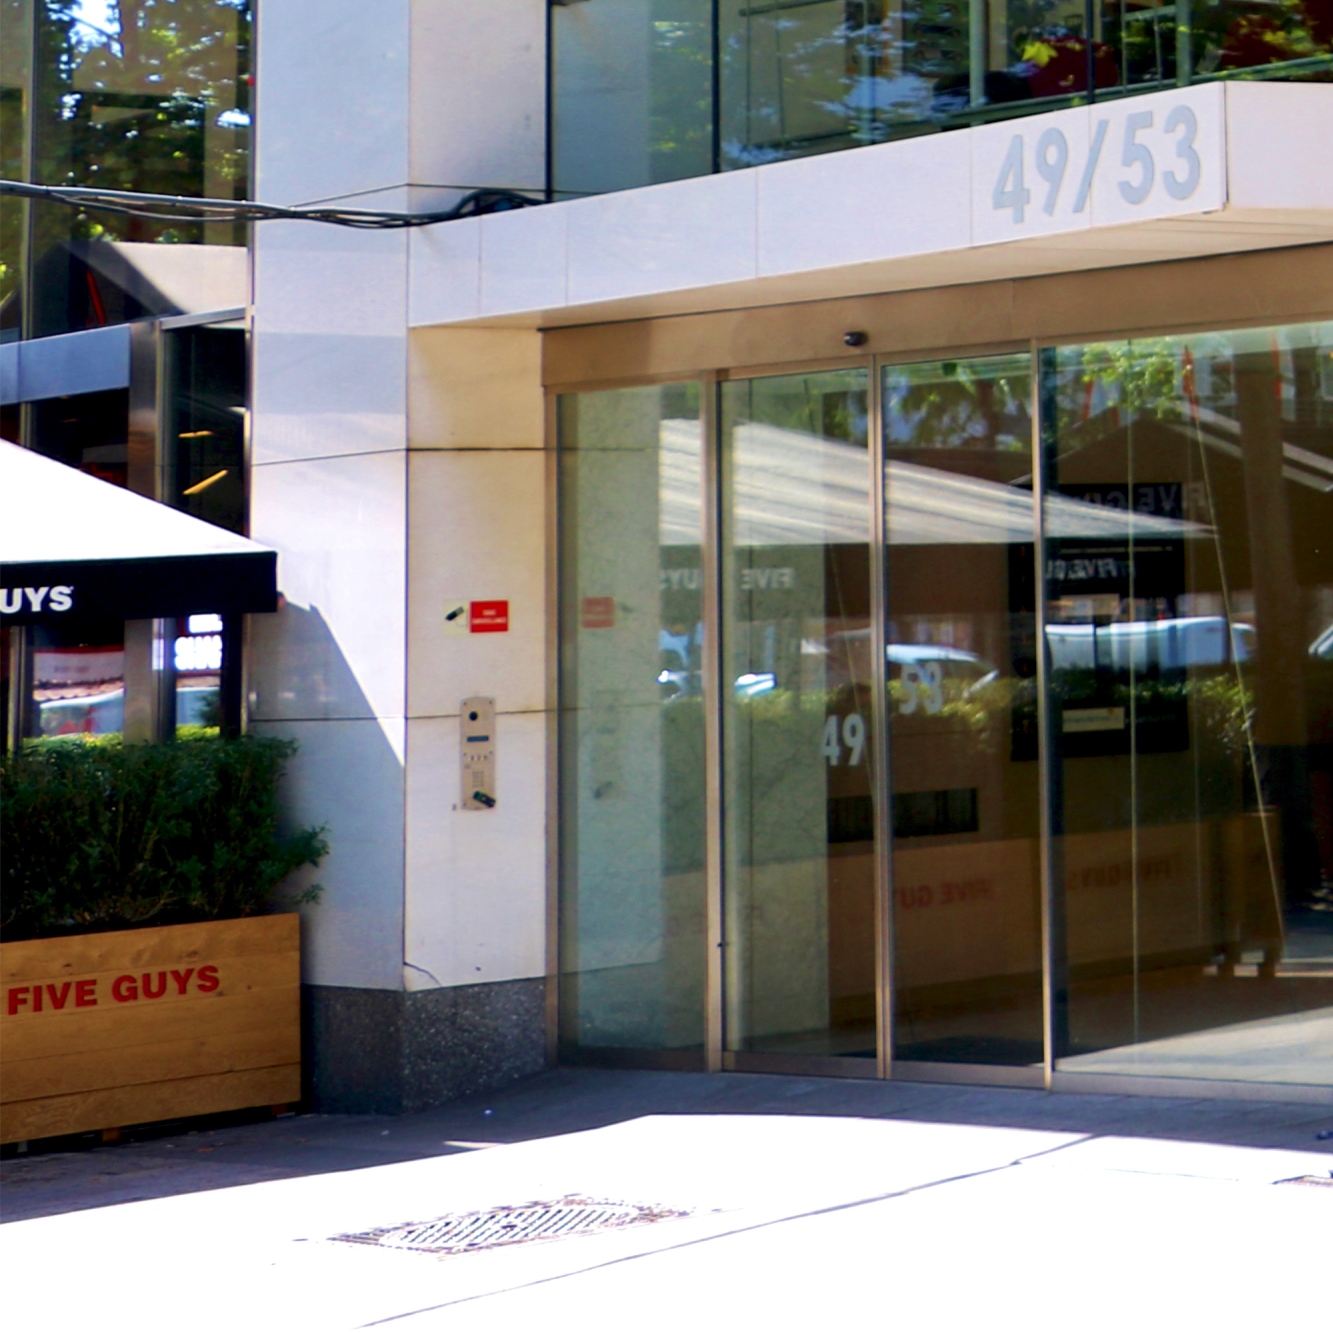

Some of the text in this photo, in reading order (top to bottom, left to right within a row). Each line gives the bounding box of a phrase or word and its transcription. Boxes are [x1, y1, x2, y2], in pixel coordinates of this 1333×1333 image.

[991, 103, 1201, 225] 49/53
[822, 712, 866, 766] 49
[7, 965, 221, 1016] FIVE GUYS
